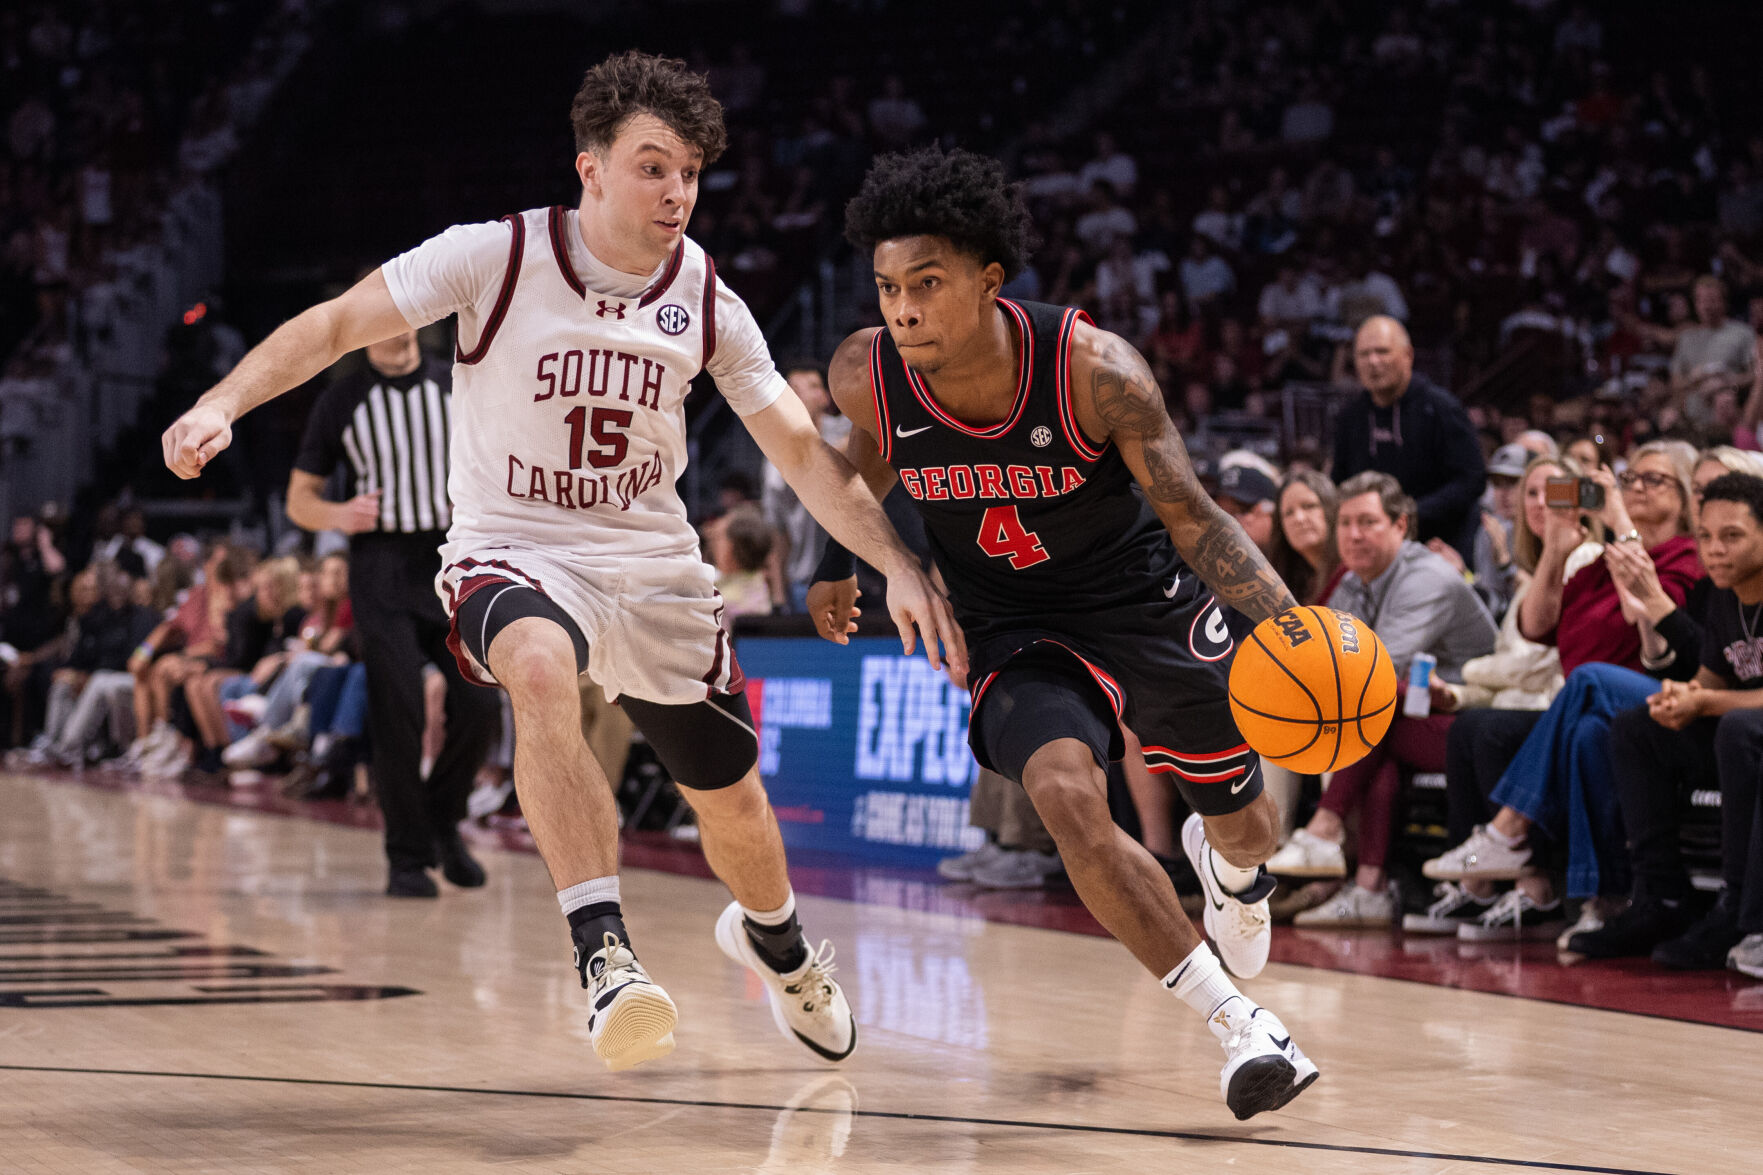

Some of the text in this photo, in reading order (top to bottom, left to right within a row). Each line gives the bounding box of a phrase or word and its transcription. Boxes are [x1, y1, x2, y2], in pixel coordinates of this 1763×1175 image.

[658, 305, 688, 334] SEC
[534, 349, 665, 411] SOUTH
[564, 406, 634, 470] 15
[1032, 427, 1052, 446] SEC
[900, 464, 1086, 500] GEORGIA
[976, 504, 1050, 571] 4
[1272, 610, 1312, 648] CAA
[853, 655, 978, 787] EXPEC
